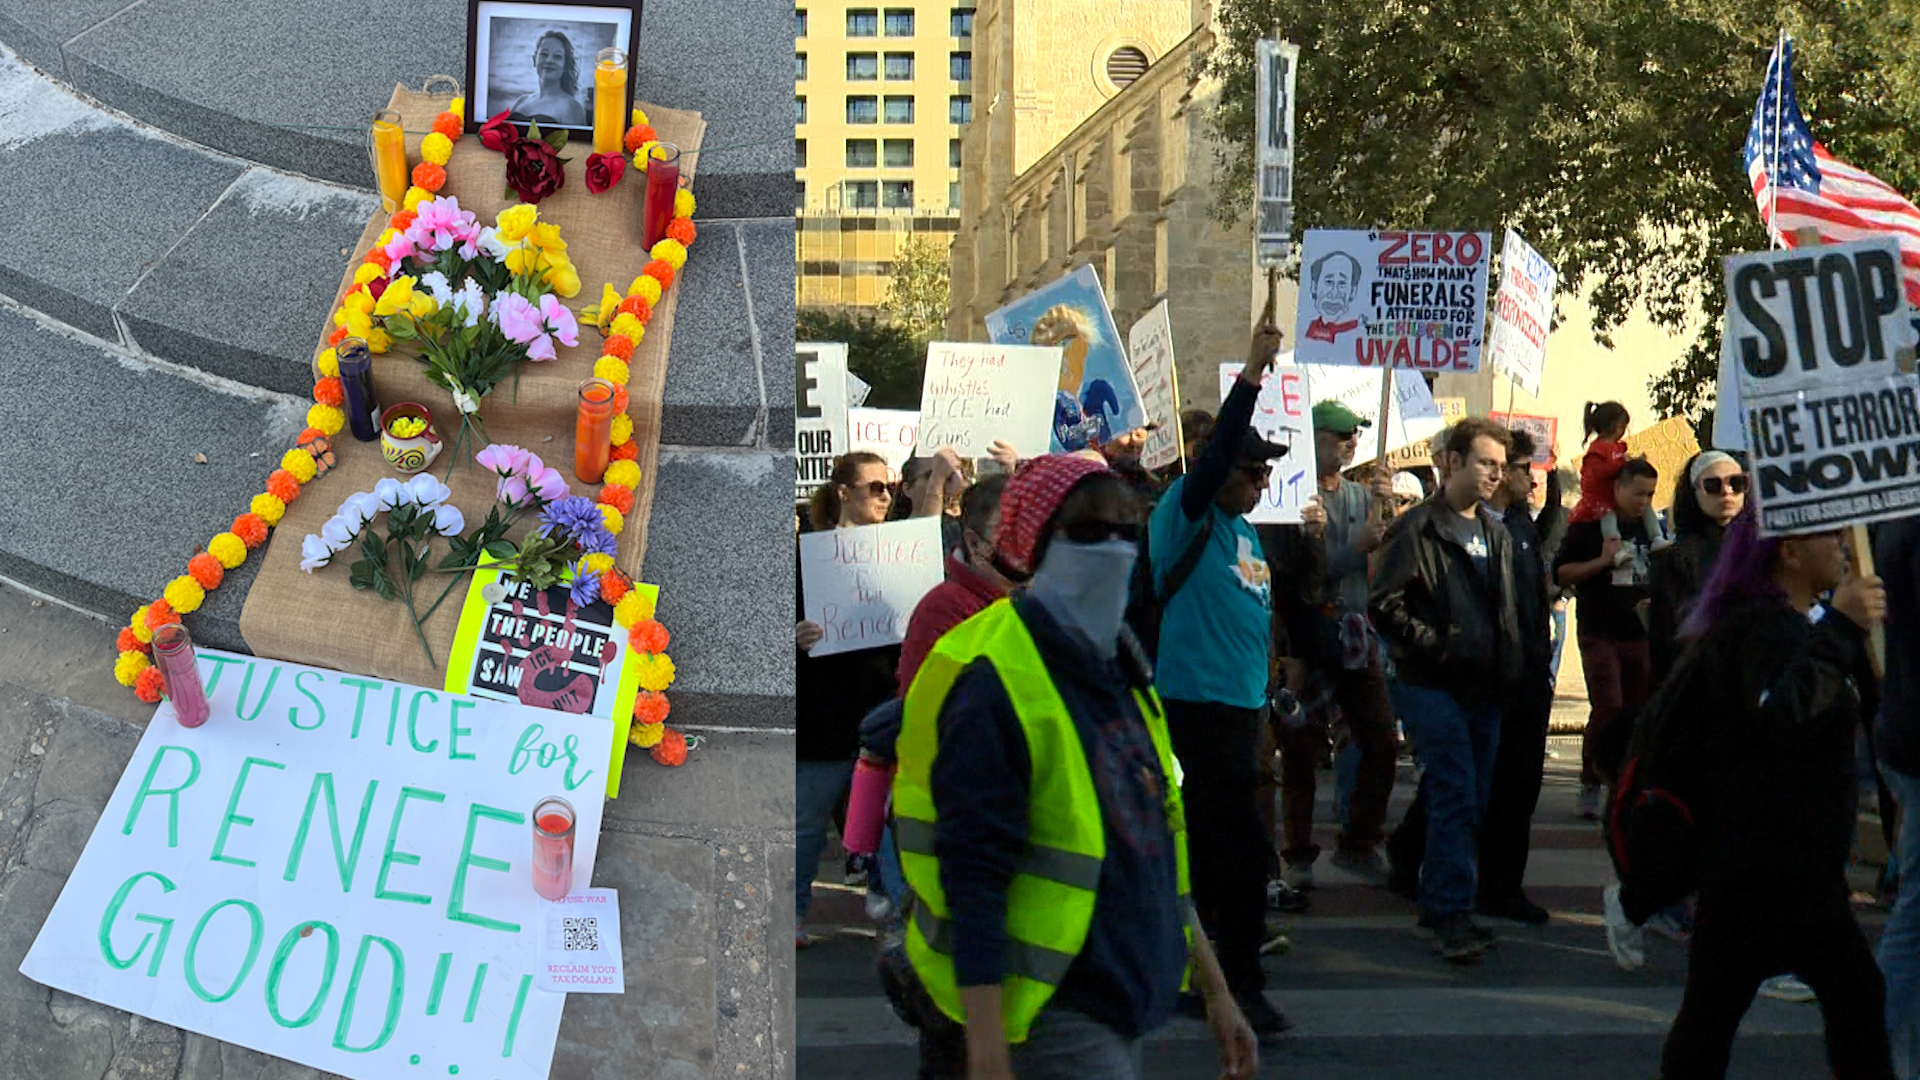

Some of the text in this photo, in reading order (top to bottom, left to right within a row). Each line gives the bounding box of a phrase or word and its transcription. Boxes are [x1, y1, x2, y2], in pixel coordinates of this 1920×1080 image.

[1413, 267, 1435, 279] HOW
[1437, 267, 1477, 282] MANY
[1371, 281, 1475, 309] FUNERALS
[1376, 306, 1475, 323] I ATTENDED FOR
[1734, 249, 1899, 378] STOP
[1365, 321, 1473, 339] THE CHILDREN OF
[940, 351, 974, 378] They
[856, 421, 888, 442] ICE
[1750, 403, 1804, 460] ICE
[1804, 386, 1920, 450] TERROR
[798, 430, 832, 455] OUR
[1267, 469, 1305, 507] UT
[502, 578, 532, 600] WE
[490, 613, 607, 658] THE PEOPLE
[528, 648, 556, 671] ICE
[479, 657, 525, 689] SAW
[196, 653, 594, 791] JUSTICE for
[121, 745, 526, 933] RENEE
[586, 895, 608, 904] WAR
[547, 964, 617, 975] RECLAIM YOUR
[552, 975, 614, 985] TAX DOLLARS
